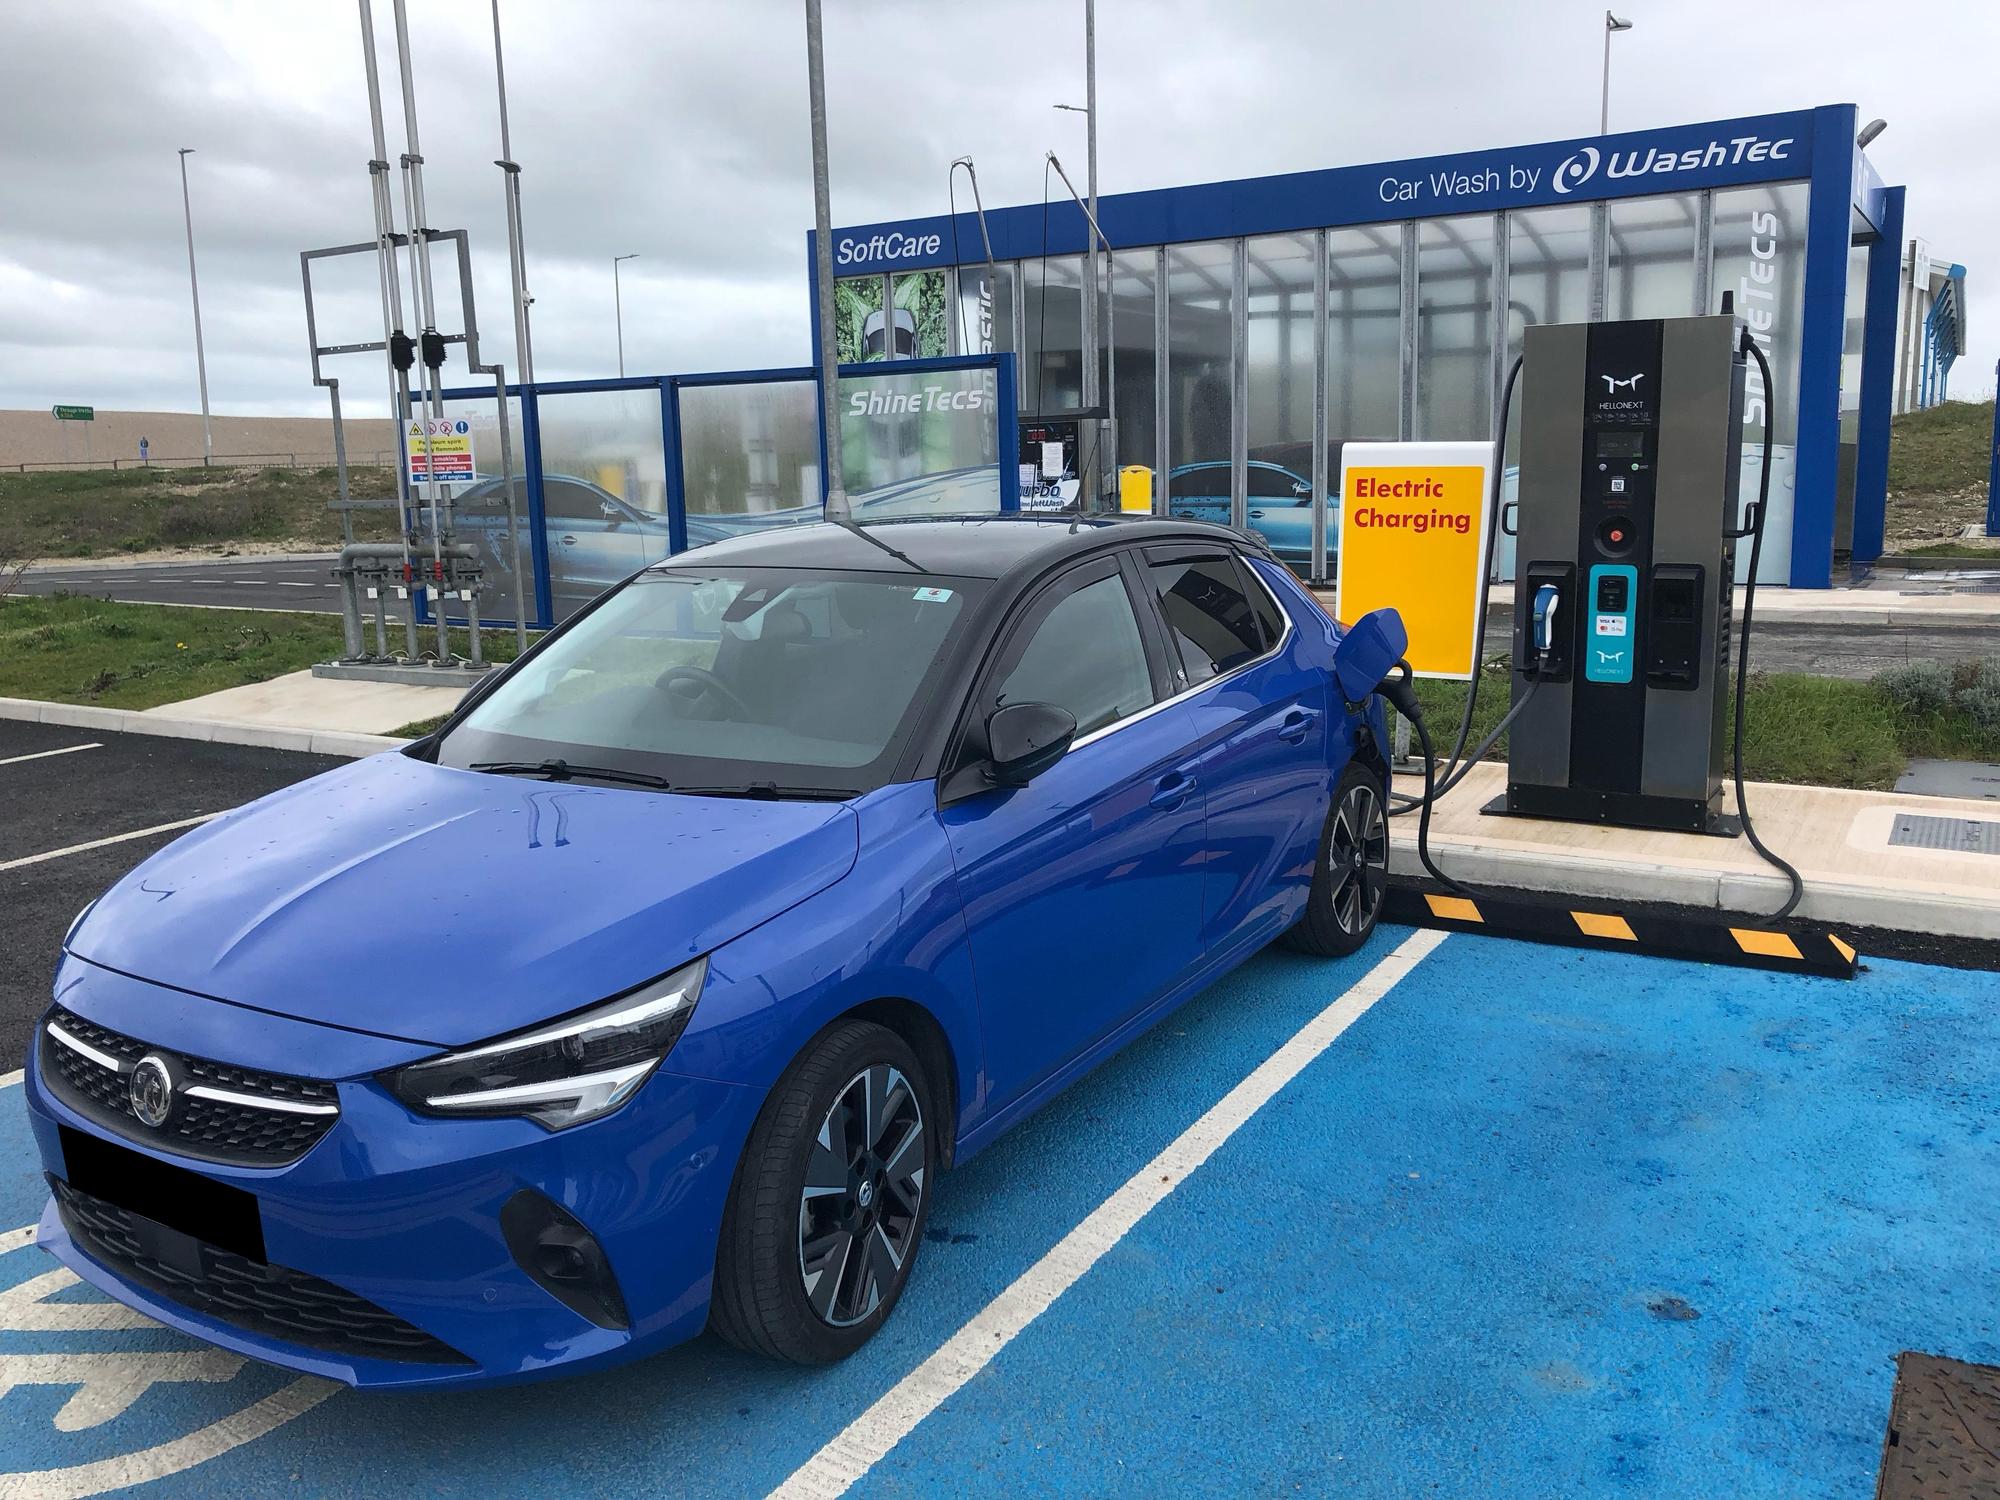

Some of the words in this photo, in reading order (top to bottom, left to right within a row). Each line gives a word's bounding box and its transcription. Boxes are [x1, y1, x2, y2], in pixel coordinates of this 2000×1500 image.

[1379, 177, 1423, 203] Car
[1430, 168, 1500, 198] Wash
[1509, 164, 1542, 193] by
[1606, 136, 1795, 179] WashTec
[837, 232, 941, 265] SoftCare
[849, 386, 983, 417] ShineTecs
[1599, 401, 1644, 410] HELLONEXT
[1020, 482, 1061, 498] urbo
[1355, 477, 1444, 498] Electric
[1354, 507, 1471, 534] Charging
